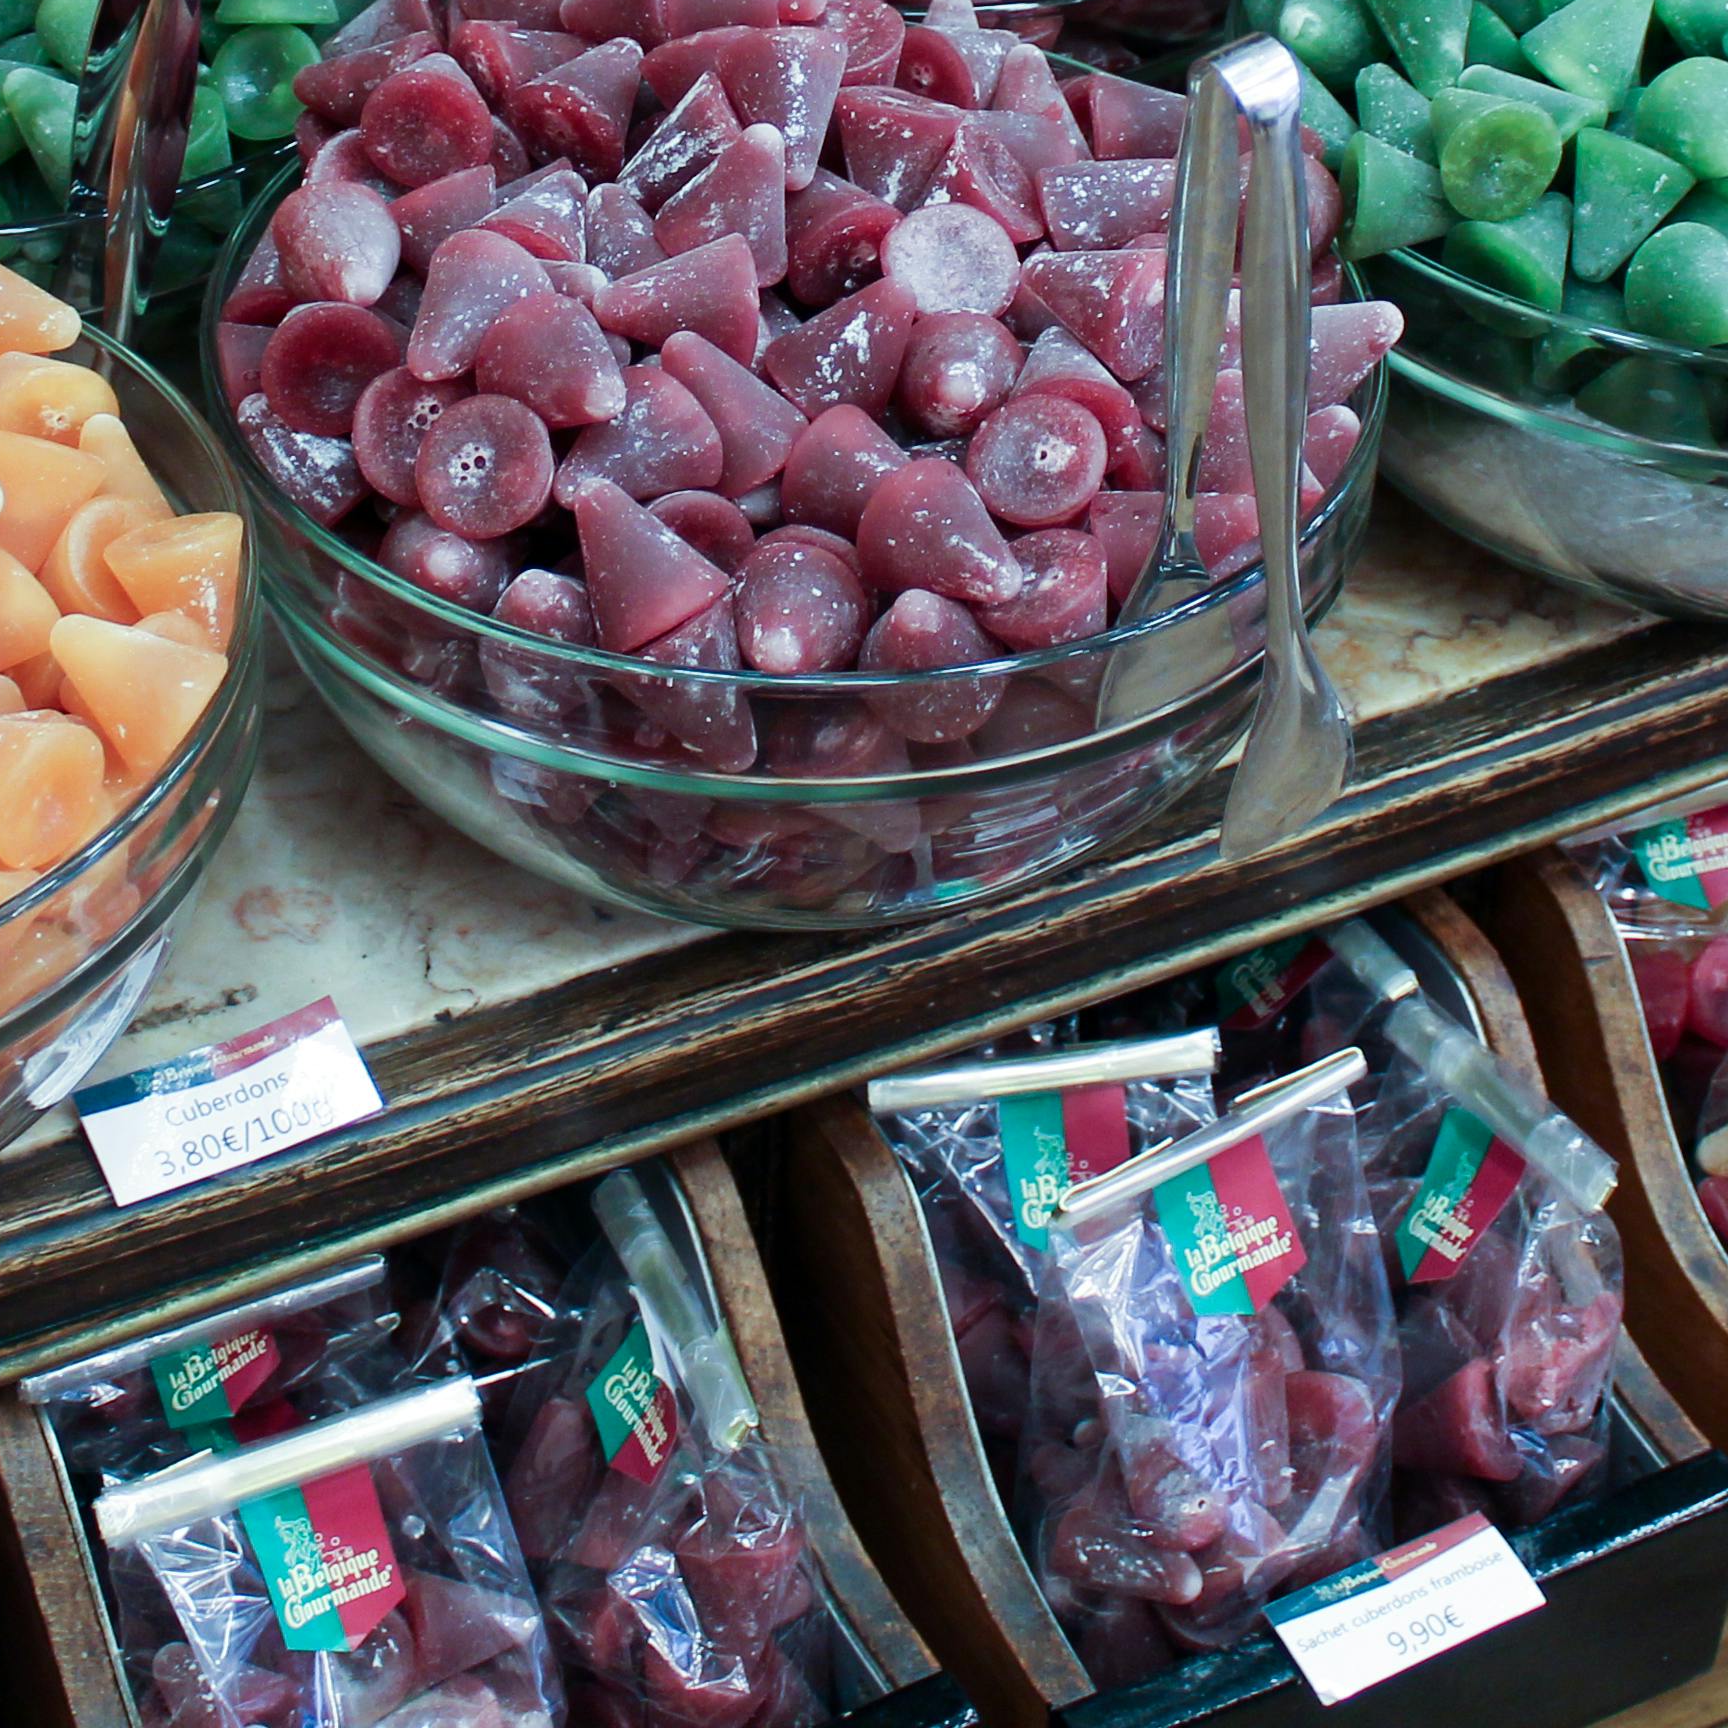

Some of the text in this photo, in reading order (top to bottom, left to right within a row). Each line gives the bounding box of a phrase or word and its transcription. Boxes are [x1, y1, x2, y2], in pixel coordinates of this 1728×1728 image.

[165, 1071, 290, 1126] Cuberdons
[154, 1094, 335, 1178] 3,80€/100g
[1183, 1215, 1279, 1269] la Belgique
[1190, 1233, 1293, 1297] Gourmande
[168, 1328, 260, 1390] la Belgique
[172, 1339, 268, 1412] Gourmande
[276, 1548, 380, 1599] la Belgique
[283, 1566, 392, 1630] Gourmande
[1295, 1551, 1504, 1653] Sachet cuberdons framboise
[1386, 1604, 1466, 1657] 9,90€
